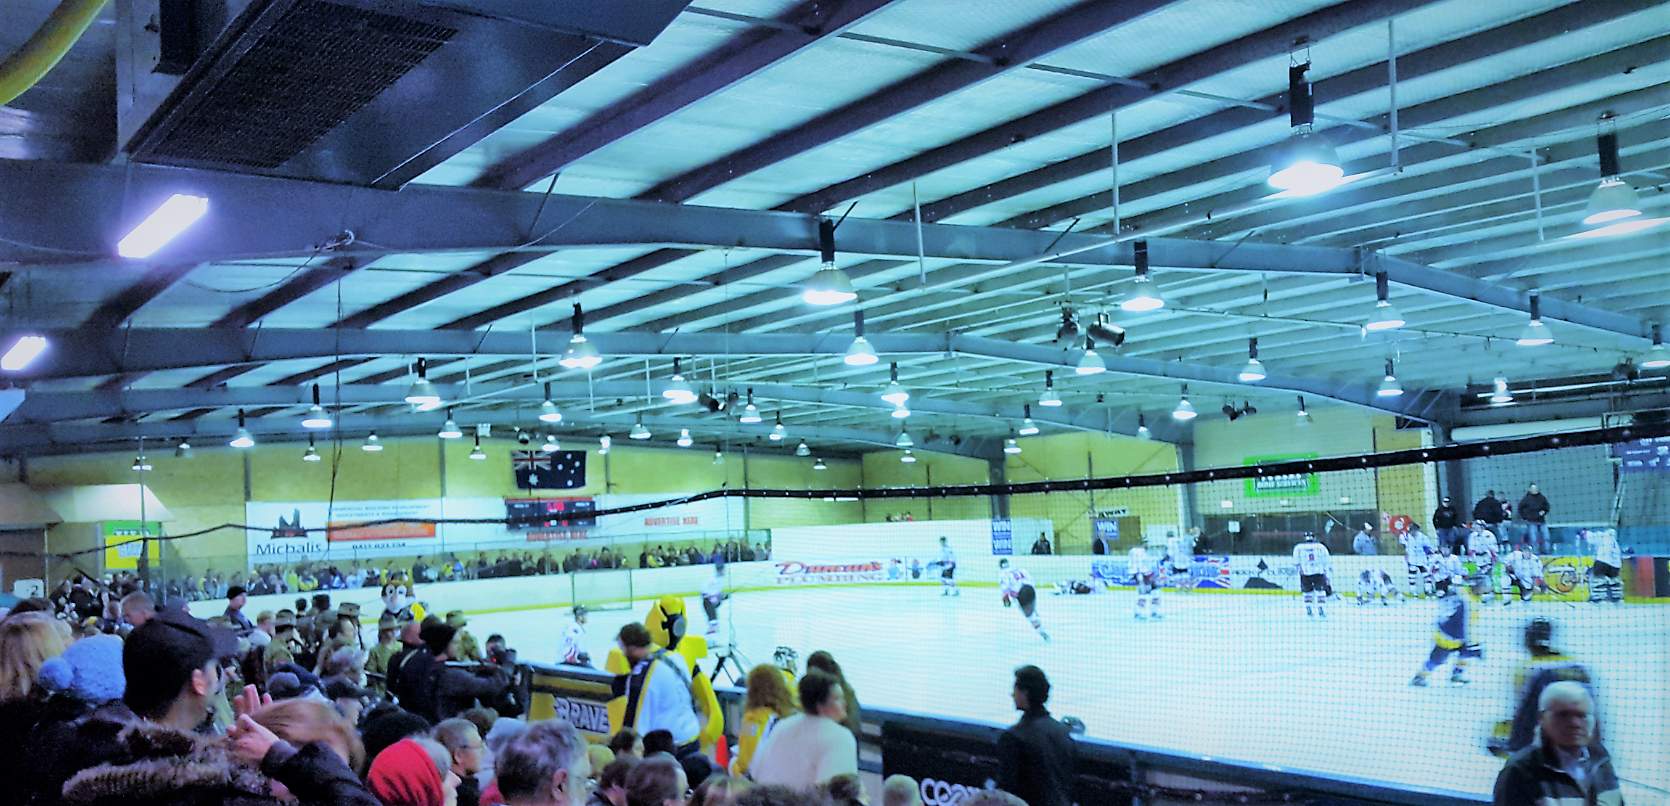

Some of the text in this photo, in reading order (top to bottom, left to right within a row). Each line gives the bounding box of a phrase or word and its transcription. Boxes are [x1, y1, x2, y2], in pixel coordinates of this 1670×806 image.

[992, 521, 1011, 532] WIN
[1096, 521, 1117, 532] WIN
[256, 542, 322, 556] Michalis
[993, 539, 1012, 549] WIN
